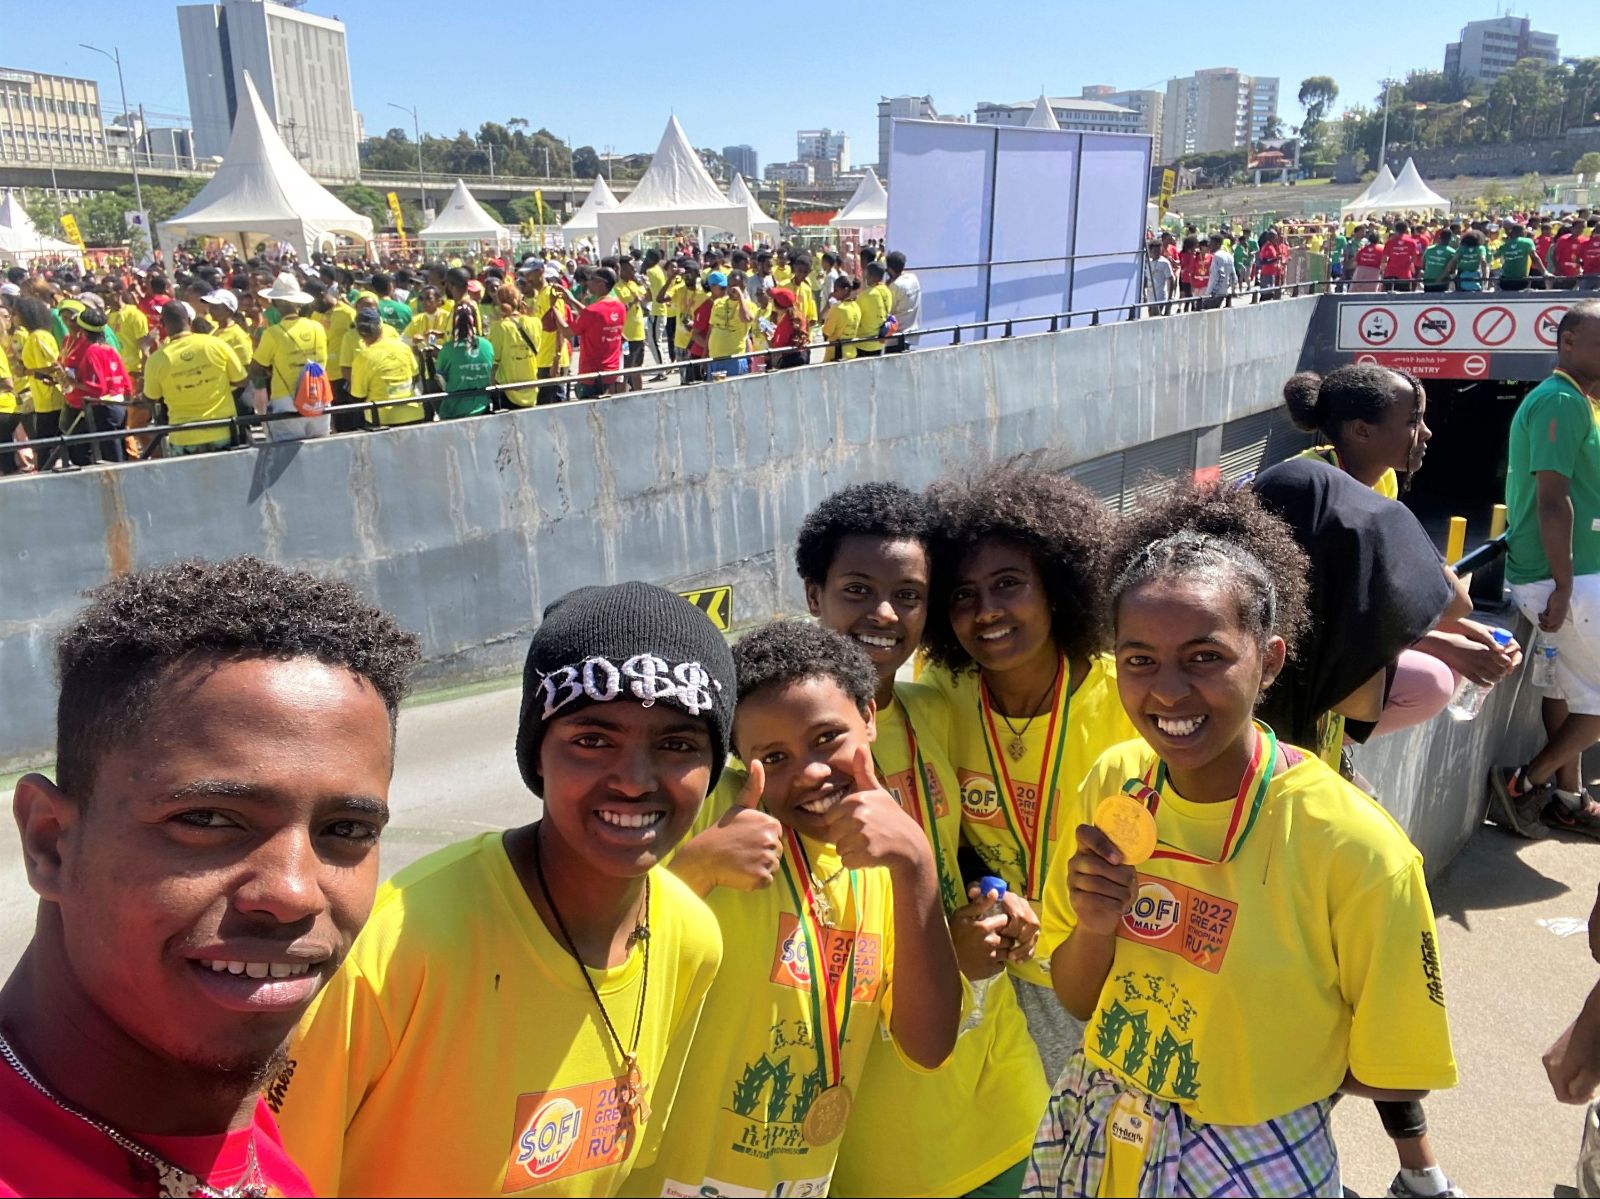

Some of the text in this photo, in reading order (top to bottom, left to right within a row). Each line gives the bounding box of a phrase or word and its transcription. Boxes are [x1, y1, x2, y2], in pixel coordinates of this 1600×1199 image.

[1413, 366, 1441, 374] ENTRY
[961, 788, 1000, 808] SOF
[1017, 786, 1036, 800] 20
[1192, 897, 1233, 923] 2022
[1134, 920, 1161, 931] MALT
[1190, 913, 1228, 935] GREAT
[1188, 926, 1223, 945] ETHIOPIAN
[782, 939, 808, 963] SO
[597, 1087, 619, 1108] 20
[518, 1110, 581, 1163] SOFI
[536, 1150, 561, 1168] MALT
